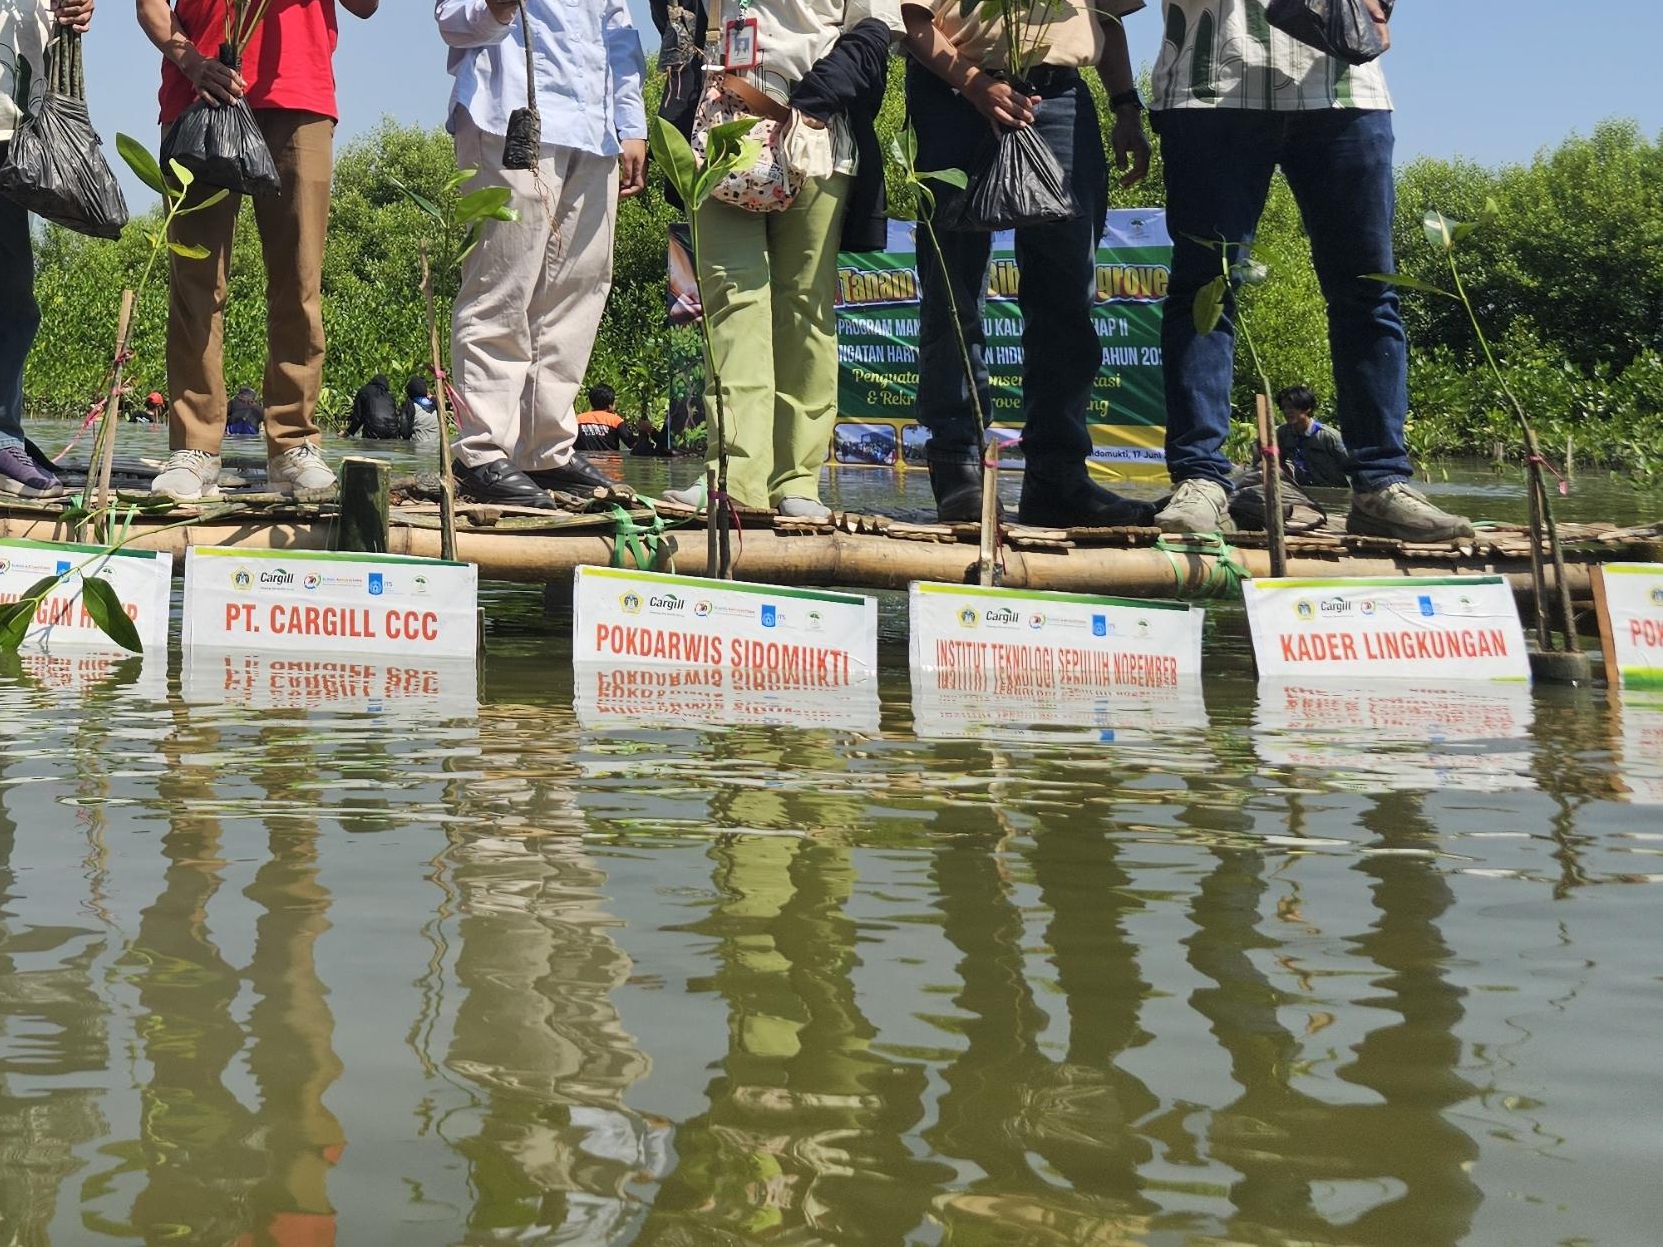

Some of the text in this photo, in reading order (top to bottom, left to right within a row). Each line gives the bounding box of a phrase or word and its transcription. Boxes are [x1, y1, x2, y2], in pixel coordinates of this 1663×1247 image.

[838, 269, 915, 302] Tanam
[838, 318, 892, 337] PROGRAM
[260, 571, 294, 586] Cargill
[650, 596, 685, 611] Cargill
[1321, 600, 1351, 613] Cargill
[225, 603, 439, 641] PT. CARGILL CCC
[986, 610, 1019, 624] Cargill
[596, 624, 723, 666] POKDARWIS
[1280, 629, 1507, 661] KADER LINGKUNGAN
